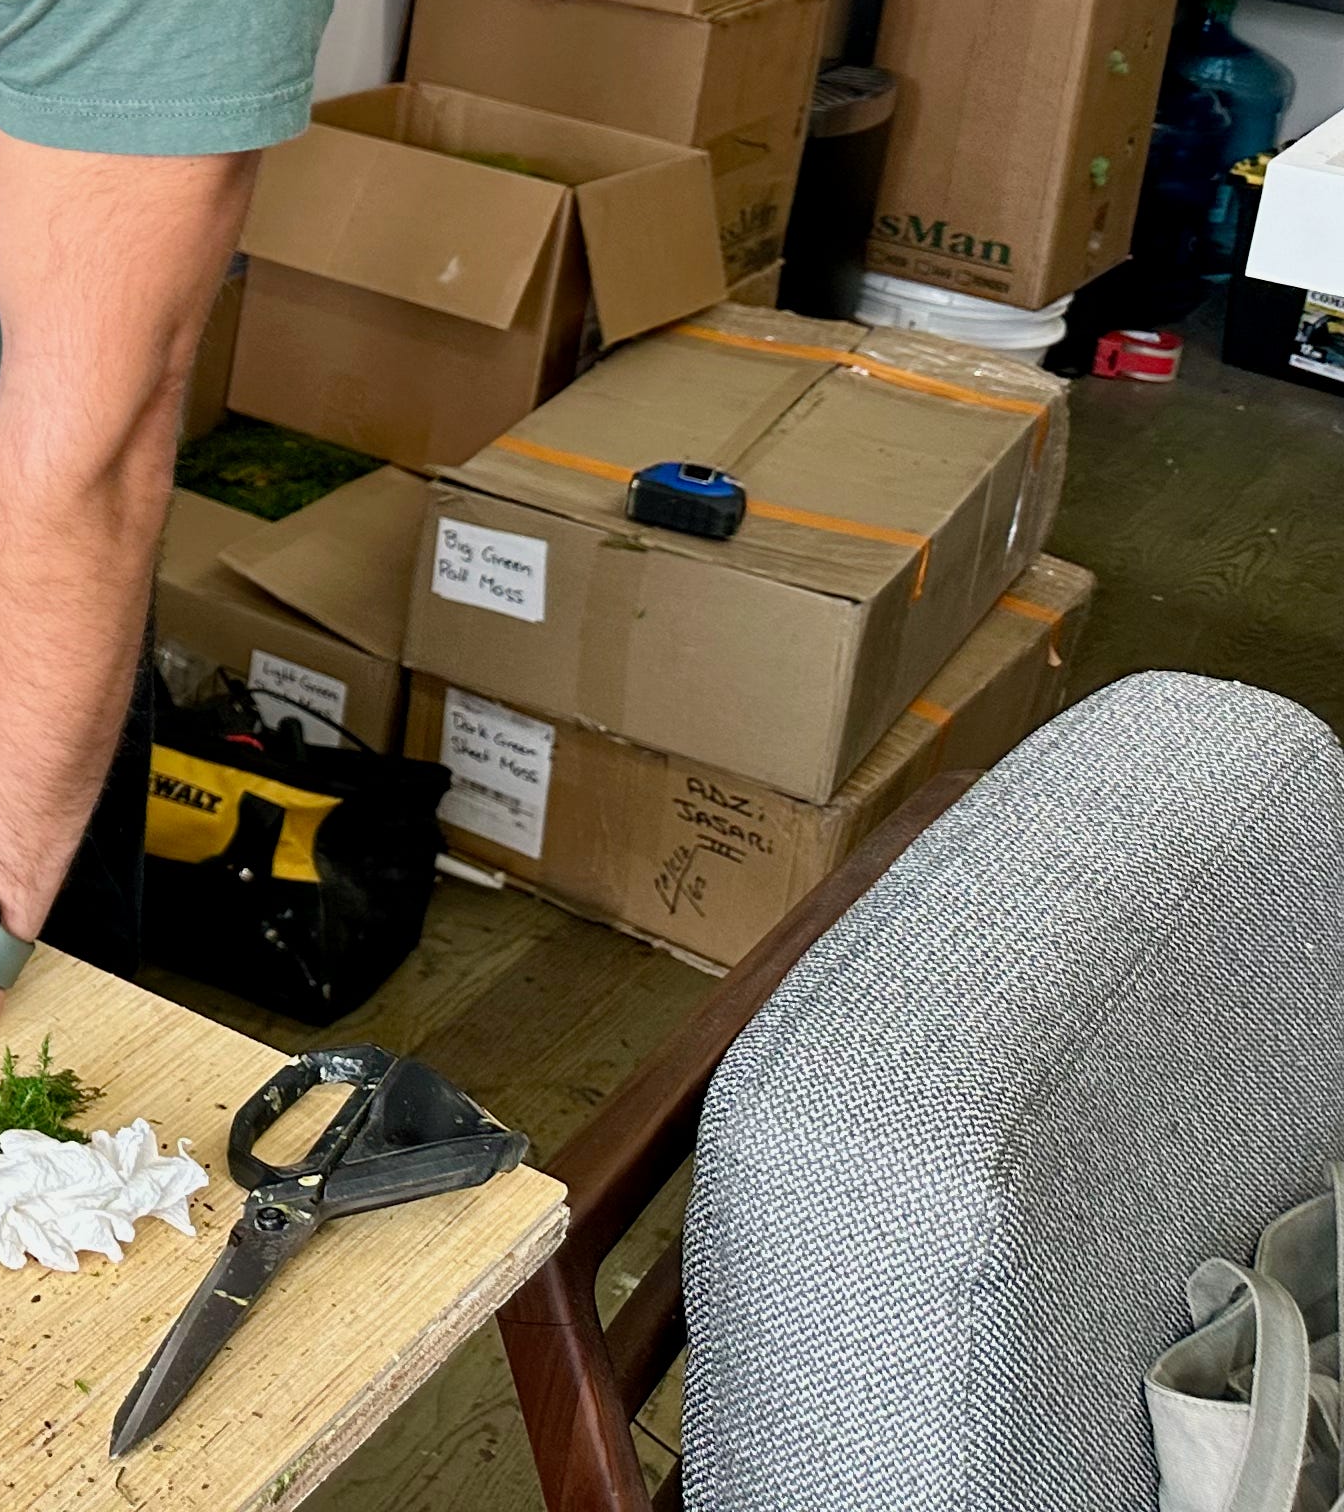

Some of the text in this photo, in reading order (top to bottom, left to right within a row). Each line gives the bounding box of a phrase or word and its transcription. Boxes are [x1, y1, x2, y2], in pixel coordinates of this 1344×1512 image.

[875, 215, 1011, 265] sMan
[443, 529, 533, 577] Big Green
[479, 574, 525, 604] Moss
[150, 771, 223, 814] WALT
